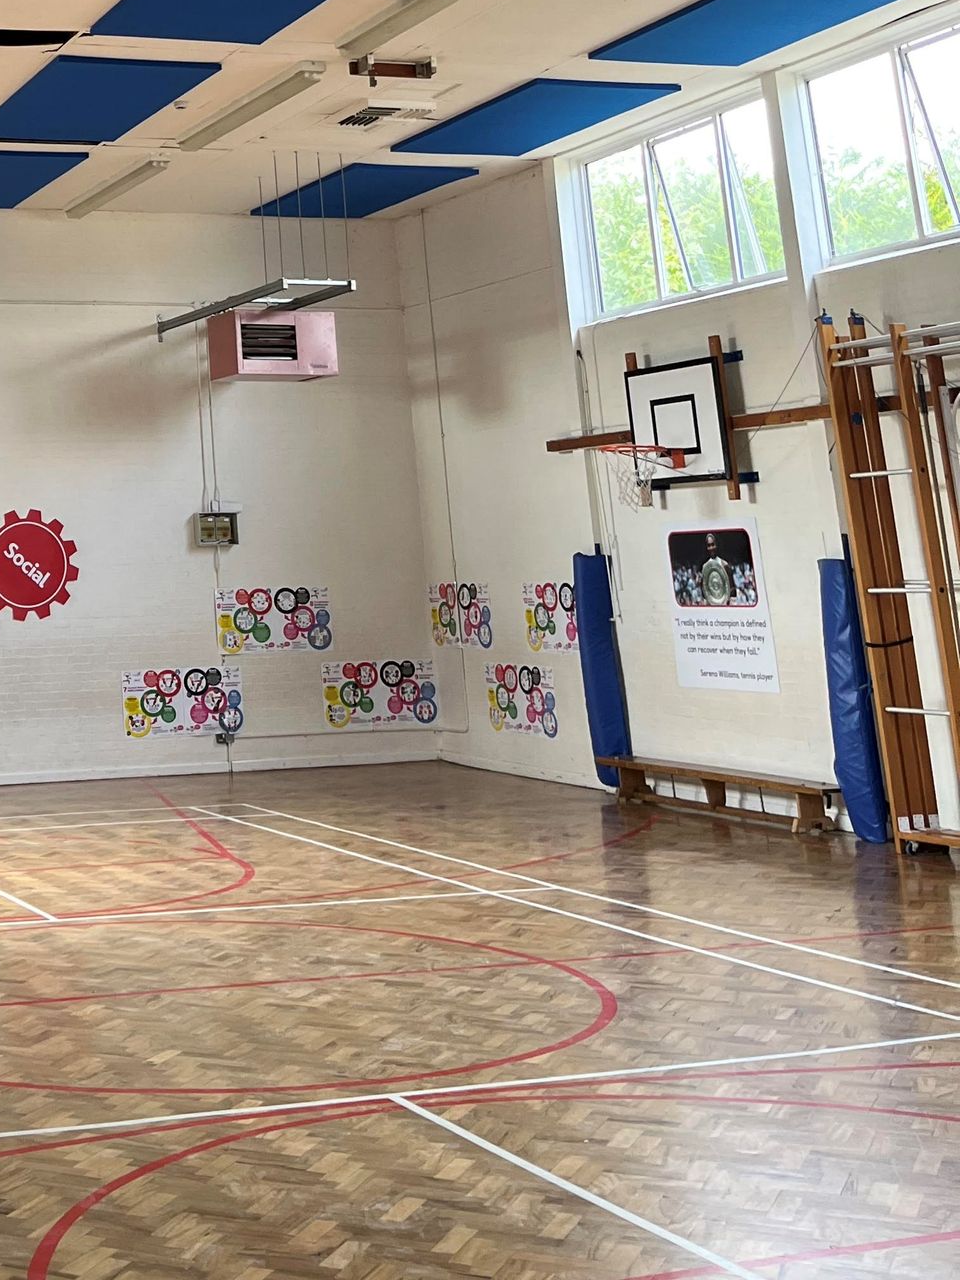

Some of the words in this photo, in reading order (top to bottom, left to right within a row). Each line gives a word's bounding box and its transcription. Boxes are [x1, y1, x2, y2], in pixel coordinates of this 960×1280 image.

[3, 543, 51, 588] Social
[681, 619, 695, 628] really
[696, 619, 708, 627] think
[714, 619, 739, 628] champion
[746, 619, 766, 628] defined
[689, 632, 695, 641] by
[722, 633, 731, 641] but
[732, 633, 739, 643] by
[740, 633, 751, 641] how
[752, 633, 765, 643] they
[734, 647, 746, 657] they
[700, 669, 718, 677] Serena
[719, 670, 740, 679] Williams,
[757, 673, 773, 682] player
